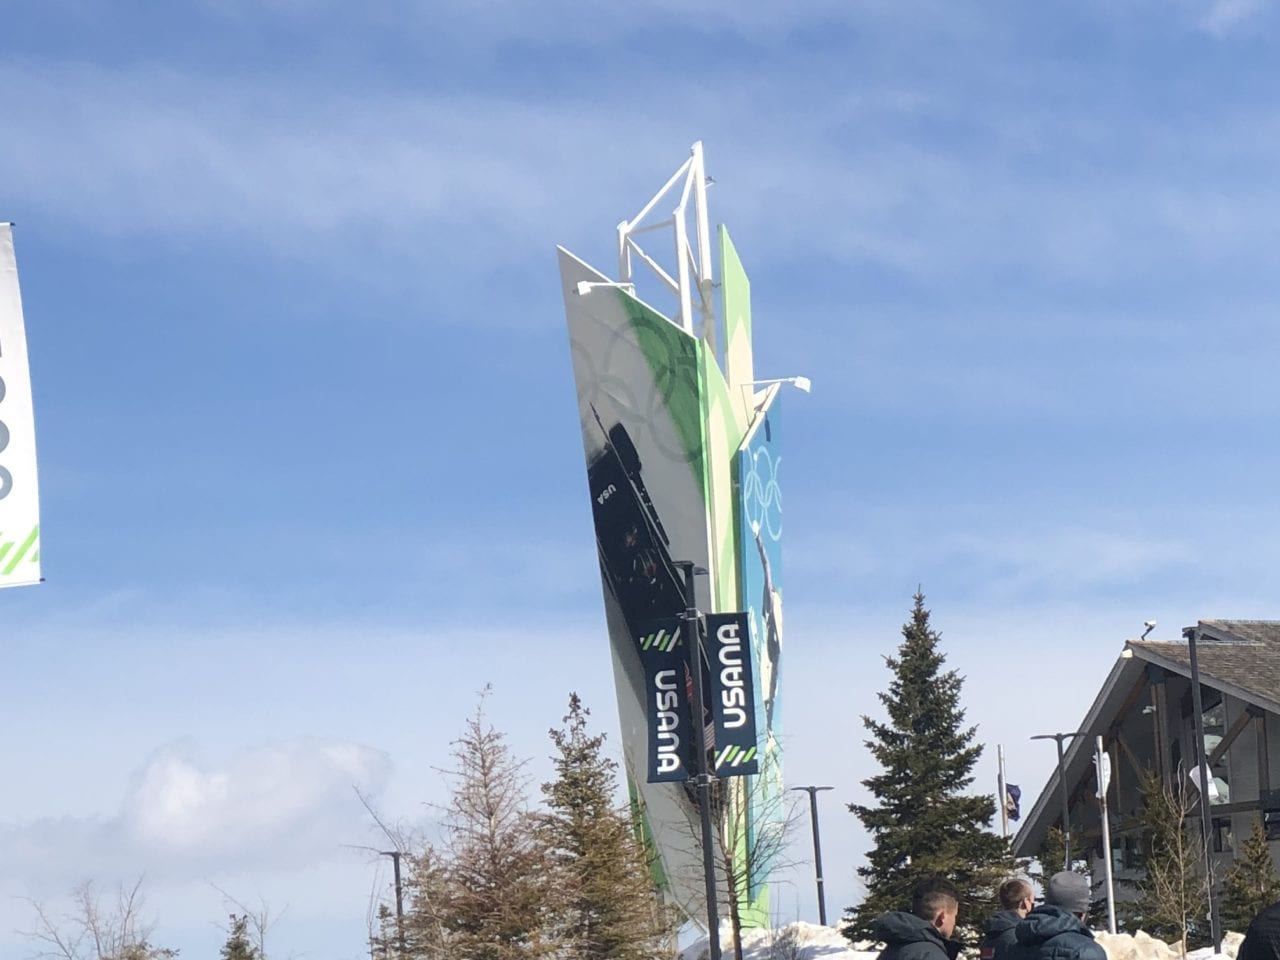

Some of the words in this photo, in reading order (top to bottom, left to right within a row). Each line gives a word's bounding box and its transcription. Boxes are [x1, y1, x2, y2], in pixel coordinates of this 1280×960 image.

[597, 484, 617, 505] USA
[654, 669, 680, 775] USANA
[716, 622, 747, 729] USANA
